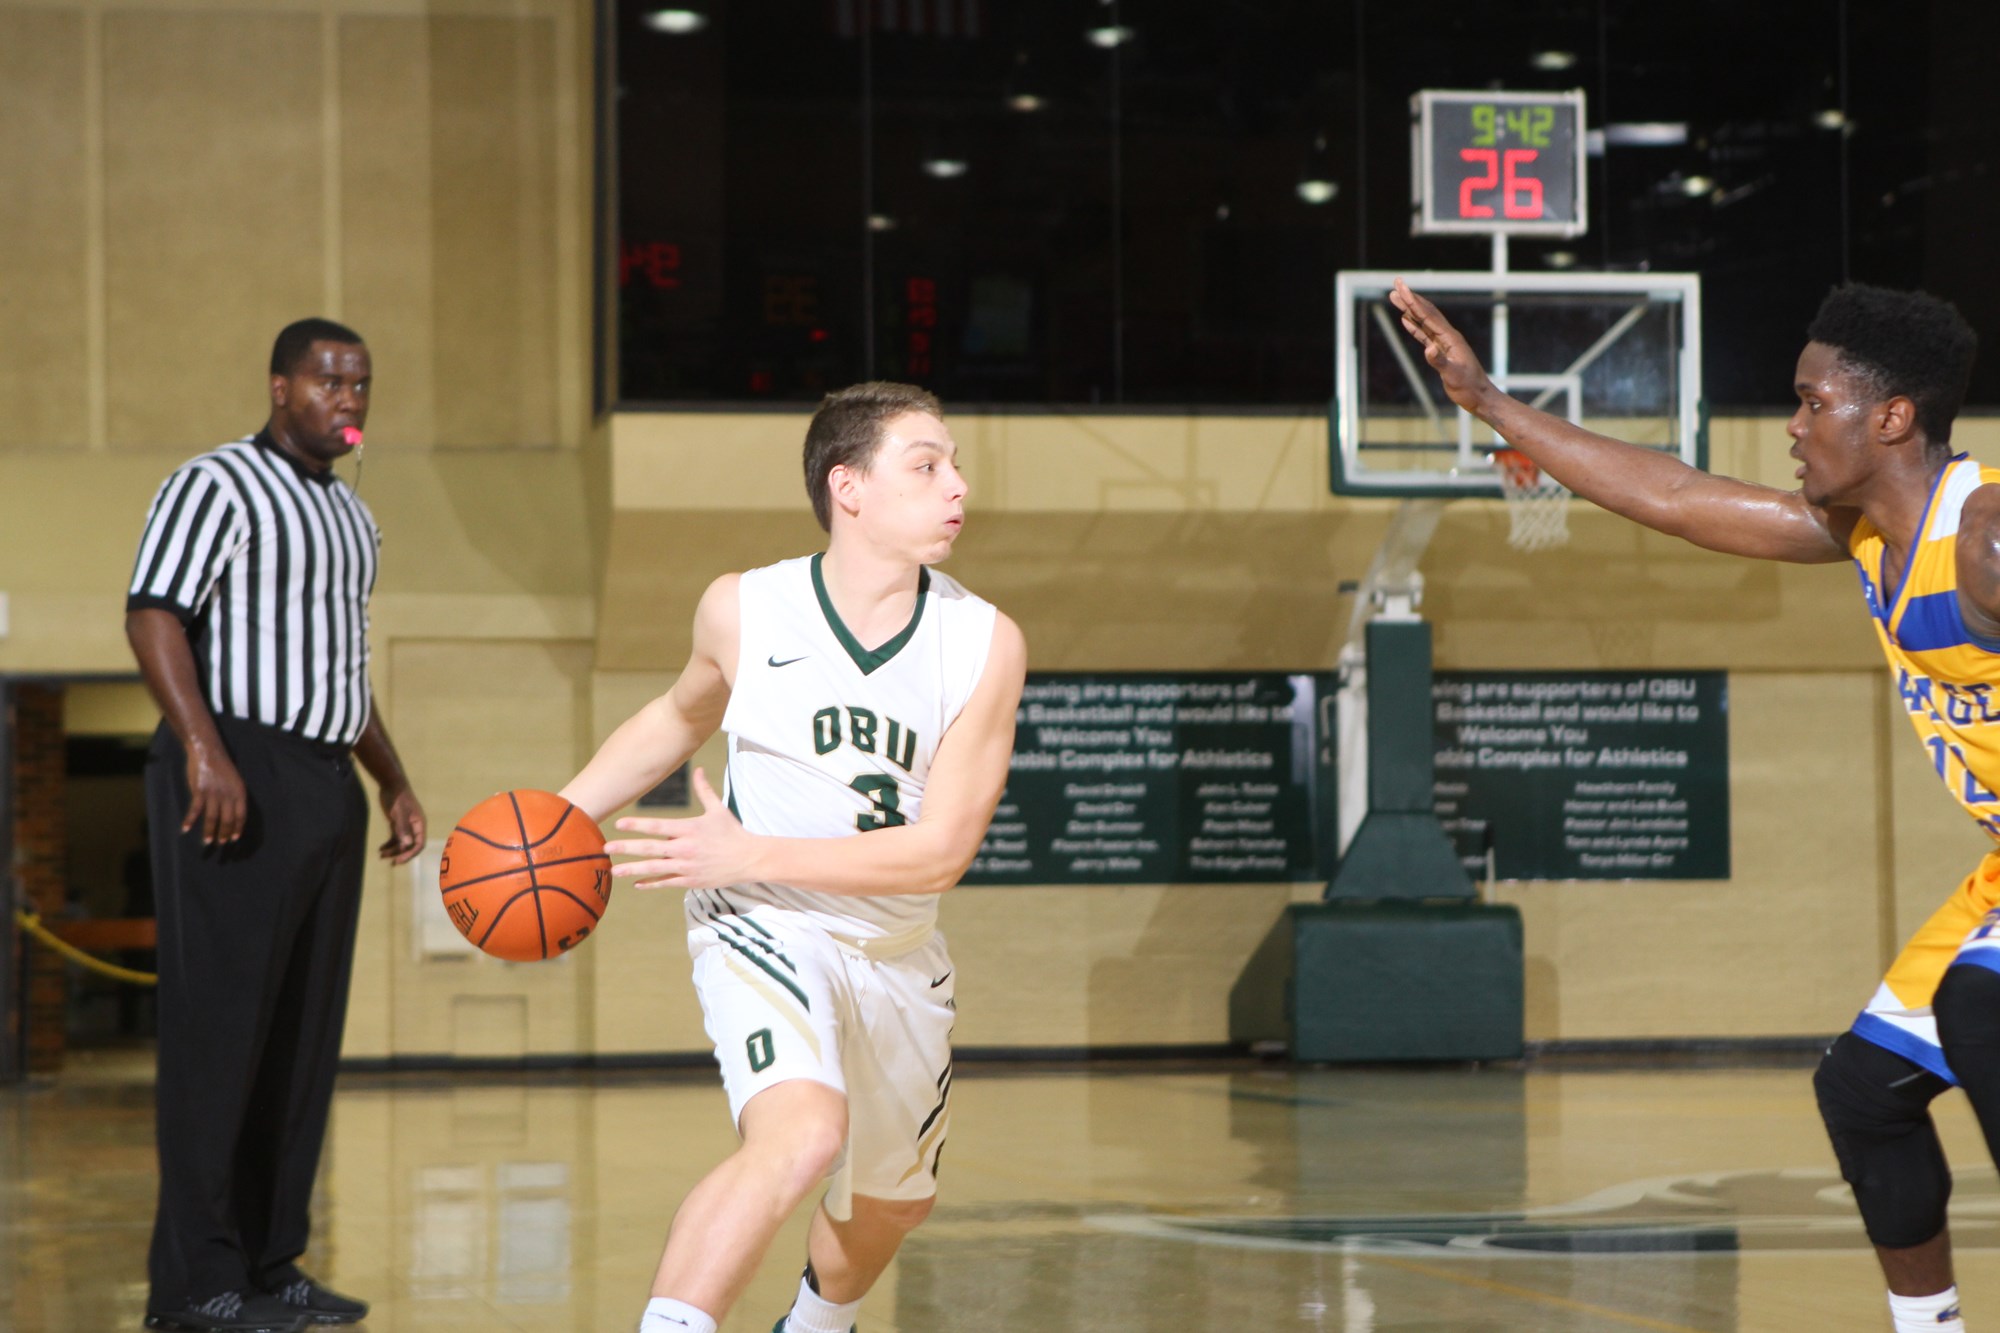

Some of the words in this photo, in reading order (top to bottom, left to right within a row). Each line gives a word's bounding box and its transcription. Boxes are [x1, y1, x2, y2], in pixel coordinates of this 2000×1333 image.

[1471, 104, 1555, 147] 9:42
[1459, 148, 1543, 219] 26
[1083, 684, 1116, 699] are
[1119, 683, 1232, 703] supporters
[1235, 681, 1257, 699] of
[1475, 683, 1509, 699] are
[1512, 682, 1622, 703] supporters
[1625, 680, 1645, 698] of
[1648, 679, 1696, 699] OBU
[1028, 704, 1134, 722] Basketball
[1136, 704, 1172, 722] and
[1176, 704, 1234, 722] would
[1237, 704, 1267, 722] like
[1437, 703, 1540, 722] Basketball
[1543, 703, 1578, 722] and
[1583, 703, 1638, 722] would
[1641, 703, 1674, 722] like
[1677, 704, 1699, 722] to
[812, 704, 918, 774] OBU
[1038, 726, 1131, 745] Welcome
[1133, 726, 1172, 745] You
[1457, 725, 1547, 744] Welcome
[1549, 725, 1588, 744] You
[1059, 750, 1145, 772] Complex
[1147, 749, 1179, 768] for
[1181, 749, 1273, 768] Athletics
[1478, 748, 1561, 771] Complex
[1564, 747, 1595, 767] for
[1597, 747, 1688, 767] Athletics
[849, 772, 907, 833] 3
